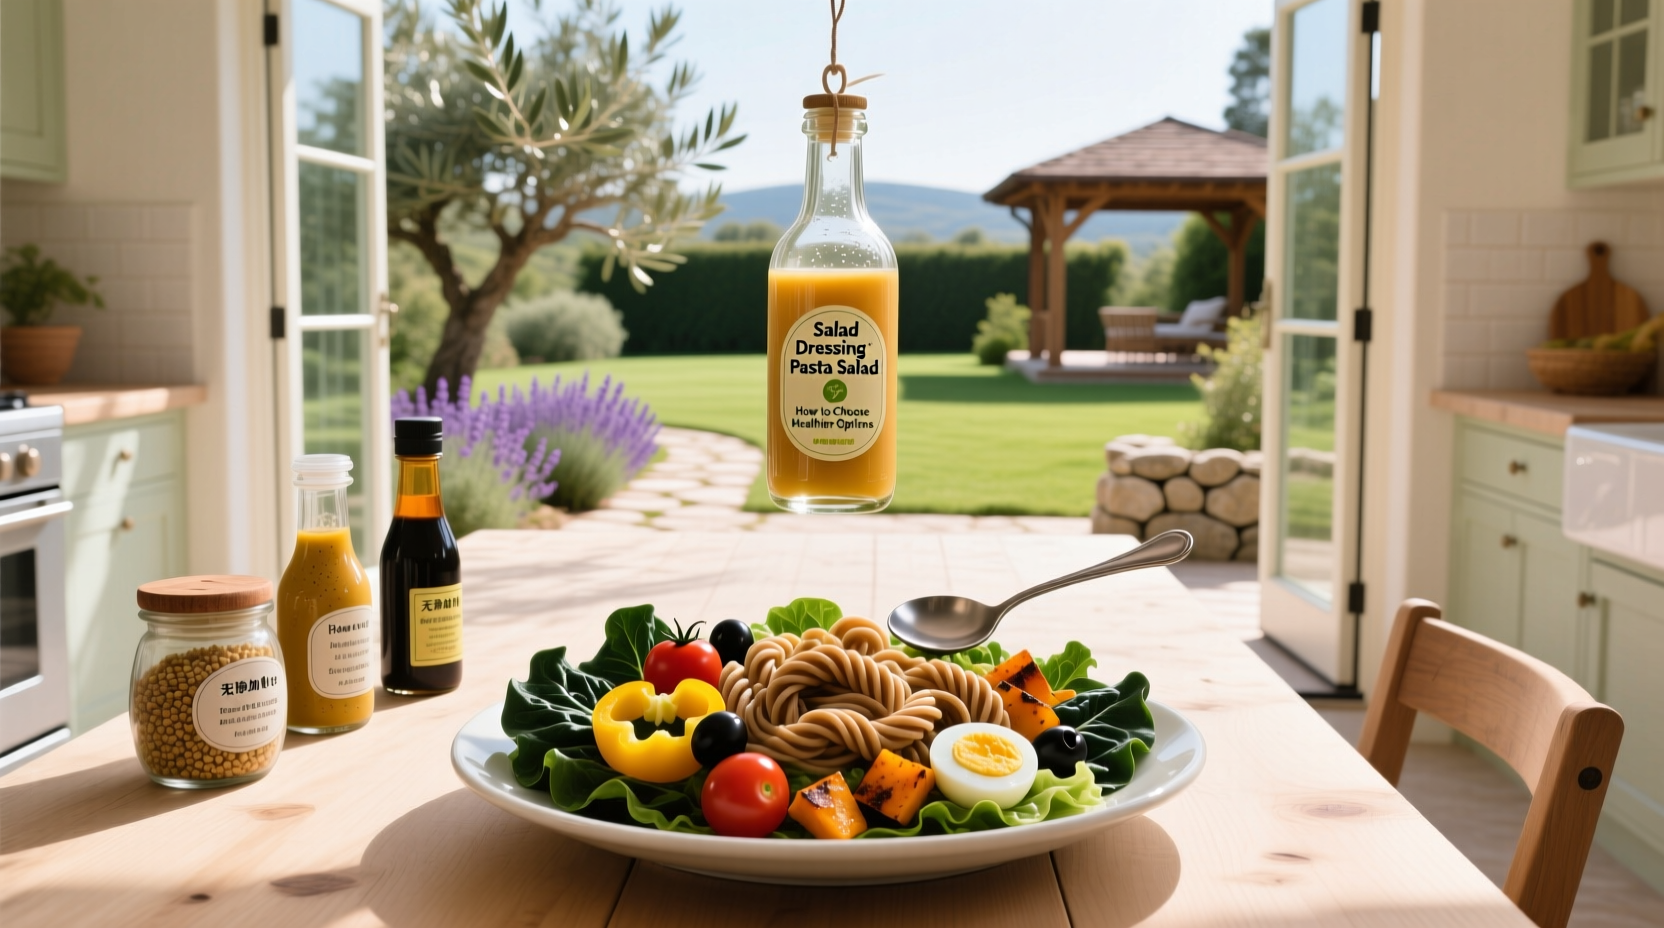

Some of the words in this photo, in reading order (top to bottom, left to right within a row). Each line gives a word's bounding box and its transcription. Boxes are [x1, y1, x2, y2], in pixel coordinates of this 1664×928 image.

[813, 320, 859, 337] Salad
[795, 339, 867, 360] Dressing
[790, 359, 833, 374] Pasta
[837, 358, 879, 375] Salad
[795, 406, 819, 416] How
